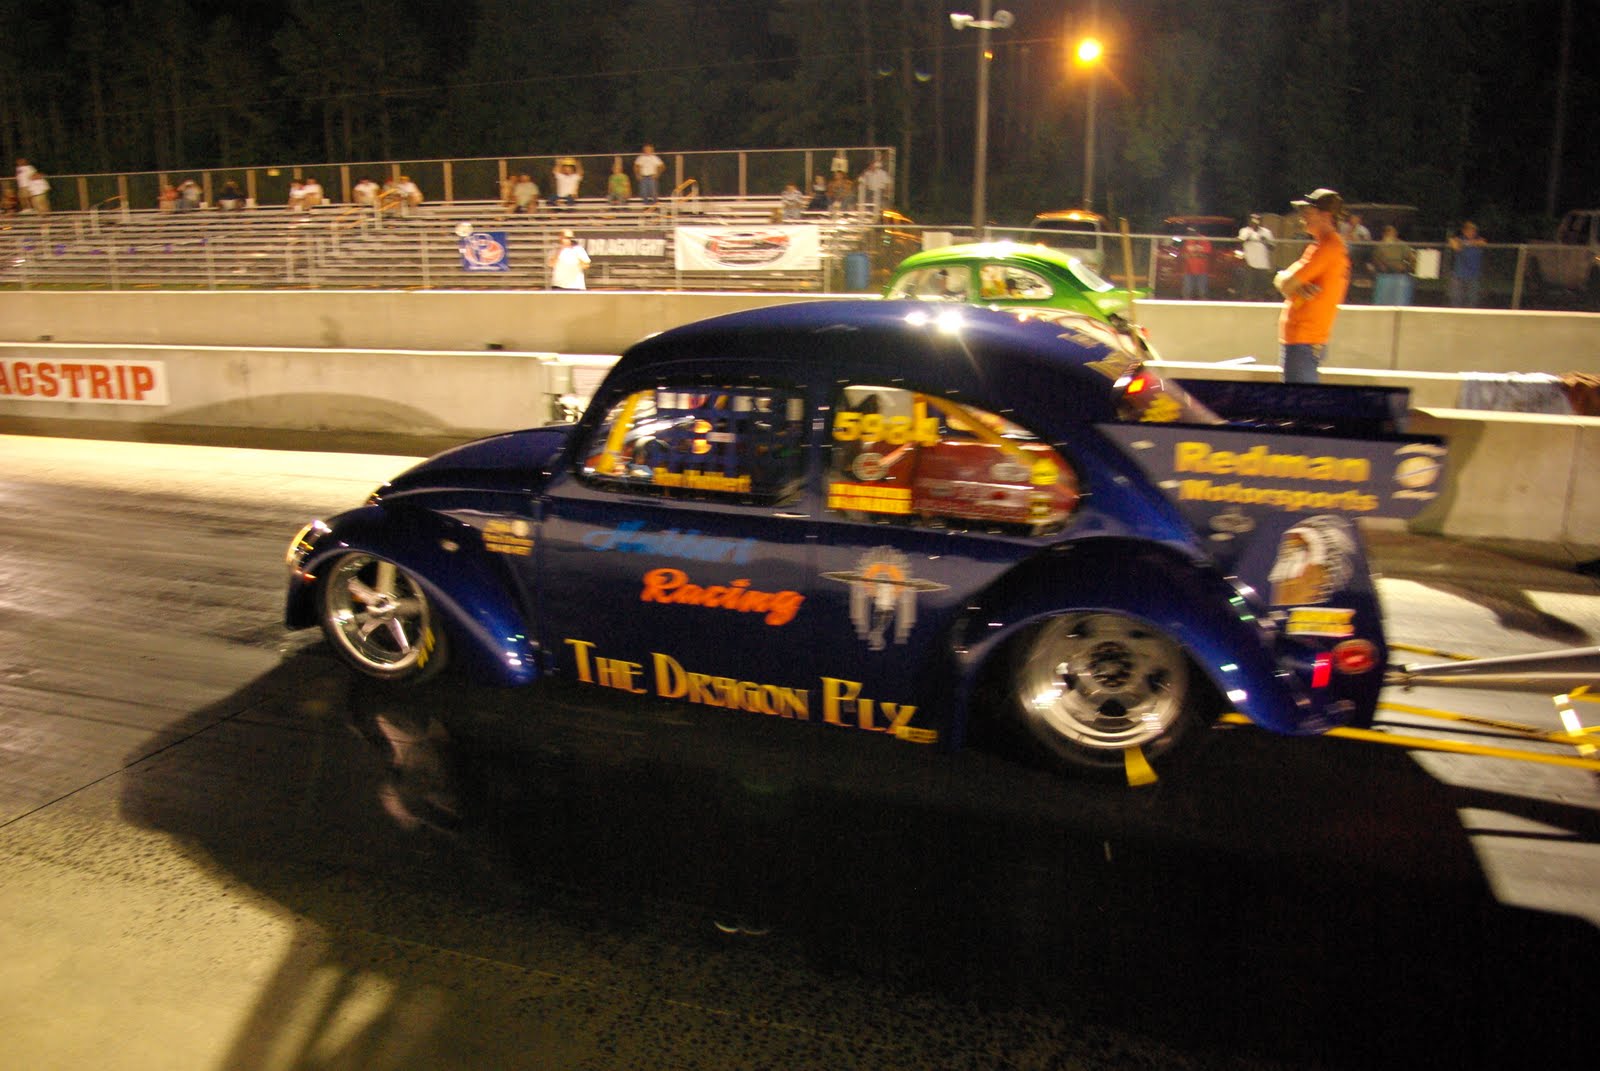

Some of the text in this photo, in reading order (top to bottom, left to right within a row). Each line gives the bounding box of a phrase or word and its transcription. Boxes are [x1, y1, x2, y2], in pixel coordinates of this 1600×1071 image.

[1174, 441, 1371, 482] Redman
[1179, 479, 1379, 511] Motorsports
[639, 567, 806, 626] Racing
